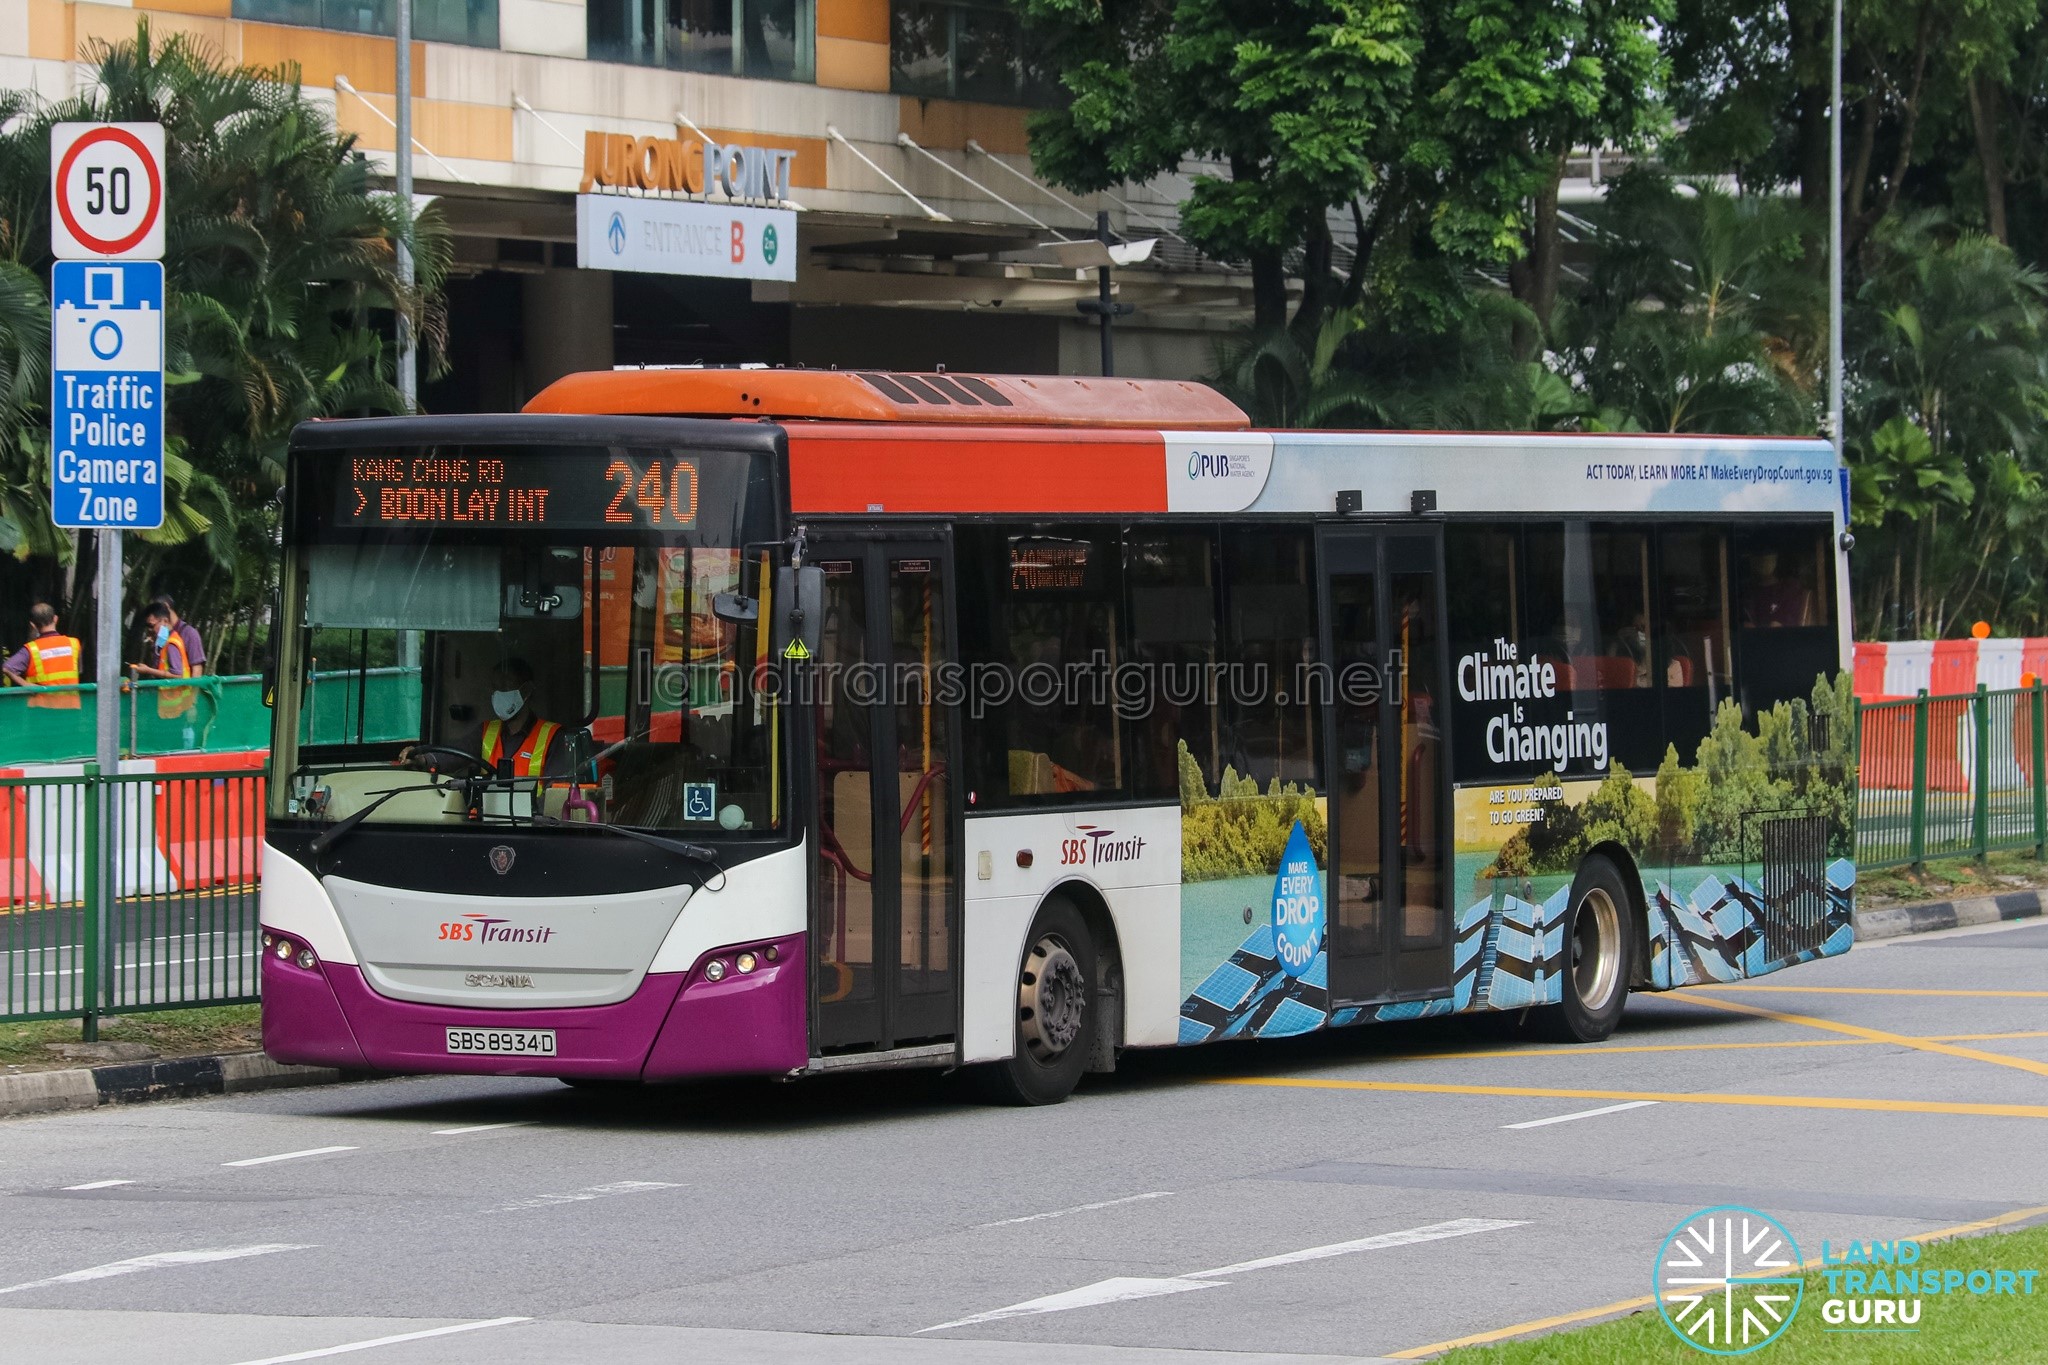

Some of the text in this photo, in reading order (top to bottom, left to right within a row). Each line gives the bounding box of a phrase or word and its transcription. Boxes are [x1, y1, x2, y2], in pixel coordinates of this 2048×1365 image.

[579, 130, 797, 200] JURONG POINT
[87, 167, 130, 215] 50
[643, 220, 745, 264] ENTRANCE B
[63, 375, 153, 410] Traffic
[70, 413, 146, 447] Police
[58, 450, 157, 485] Camera
[353, 458, 504, 483] KANG CHING RD
[1201, 454, 1229, 478] PUB
[1586, 464, 1832, 484] ACT TODAY, LEARN MORE AT MakeEveryDropCount.gov.sg
[79, 488, 137, 521] Zone
[381, 487, 549, 522] BOON LAY INT
[604, 460, 698, 523] 240
[1494, 637, 1517, 661] The
[1458, 652, 1556, 702] Climate
[1513, 702, 1524, 723] Is
[1486, 711, 1607, 773] Changing
[1489, 786, 1563, 803] ARE YOU PREPARED
[1489, 808, 1545, 825] TO GO GREEN?
[1061, 830, 1147, 868] SBS Transit
[1288, 861, 1308, 875] MAKE
[1281, 876, 1314, 896] EVERY
[1276, 896, 1319, 925] DROP
[438, 919, 557, 945] SBS Transit
[1277, 932, 1319, 967] COUNT
[465, 973, 535, 988] SCANIA
[449, 1032, 553, 1052] SBS8934D
